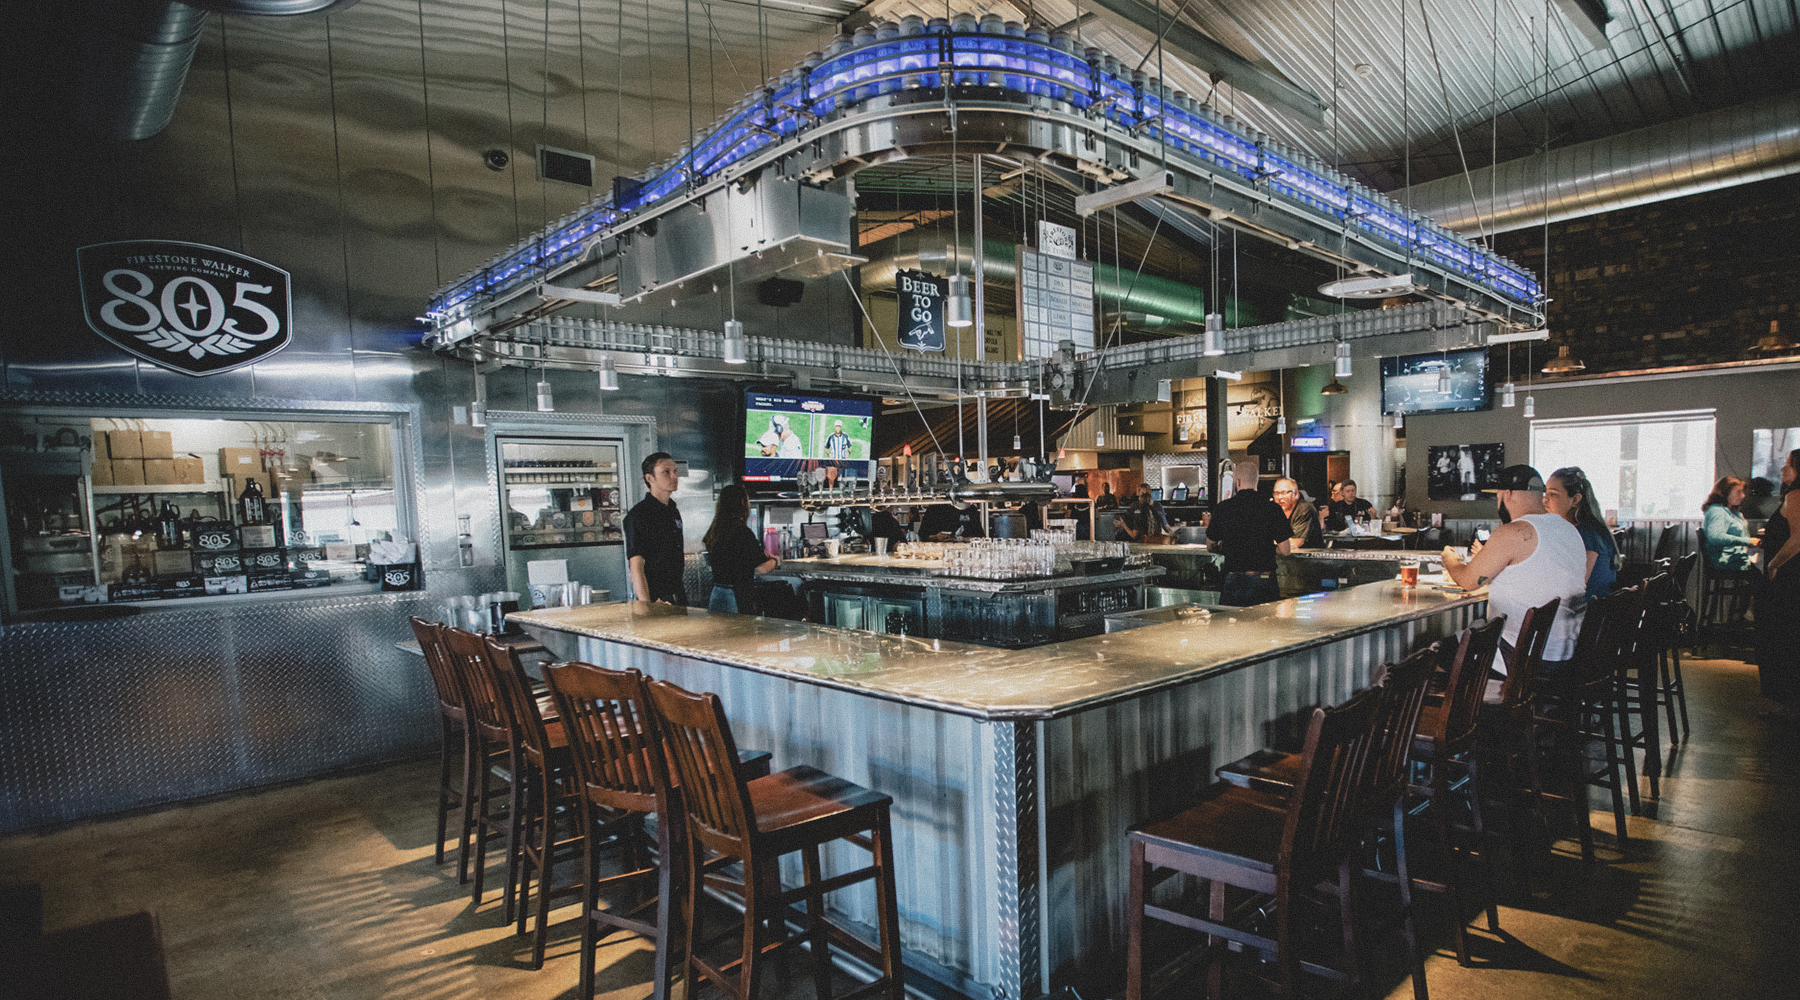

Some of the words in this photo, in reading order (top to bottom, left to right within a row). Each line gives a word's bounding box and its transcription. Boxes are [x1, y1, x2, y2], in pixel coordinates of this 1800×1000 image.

[127, 254, 198, 265] FIRESTONE
[201, 258, 250, 278] WALKER
[191, 267, 230, 279] COMPANY
[901, 275, 940, 297] BEER
[100, 268, 280, 341] 805
[912, 294, 931, 309] TO
[911, 308, 932, 323] GO
[199, 534, 231, 547] 805
[215, 556, 240, 568] 805
[257, 555, 280, 567] 805
[298, 552, 321, 562] 805
[385, 572, 410, 584] 805
